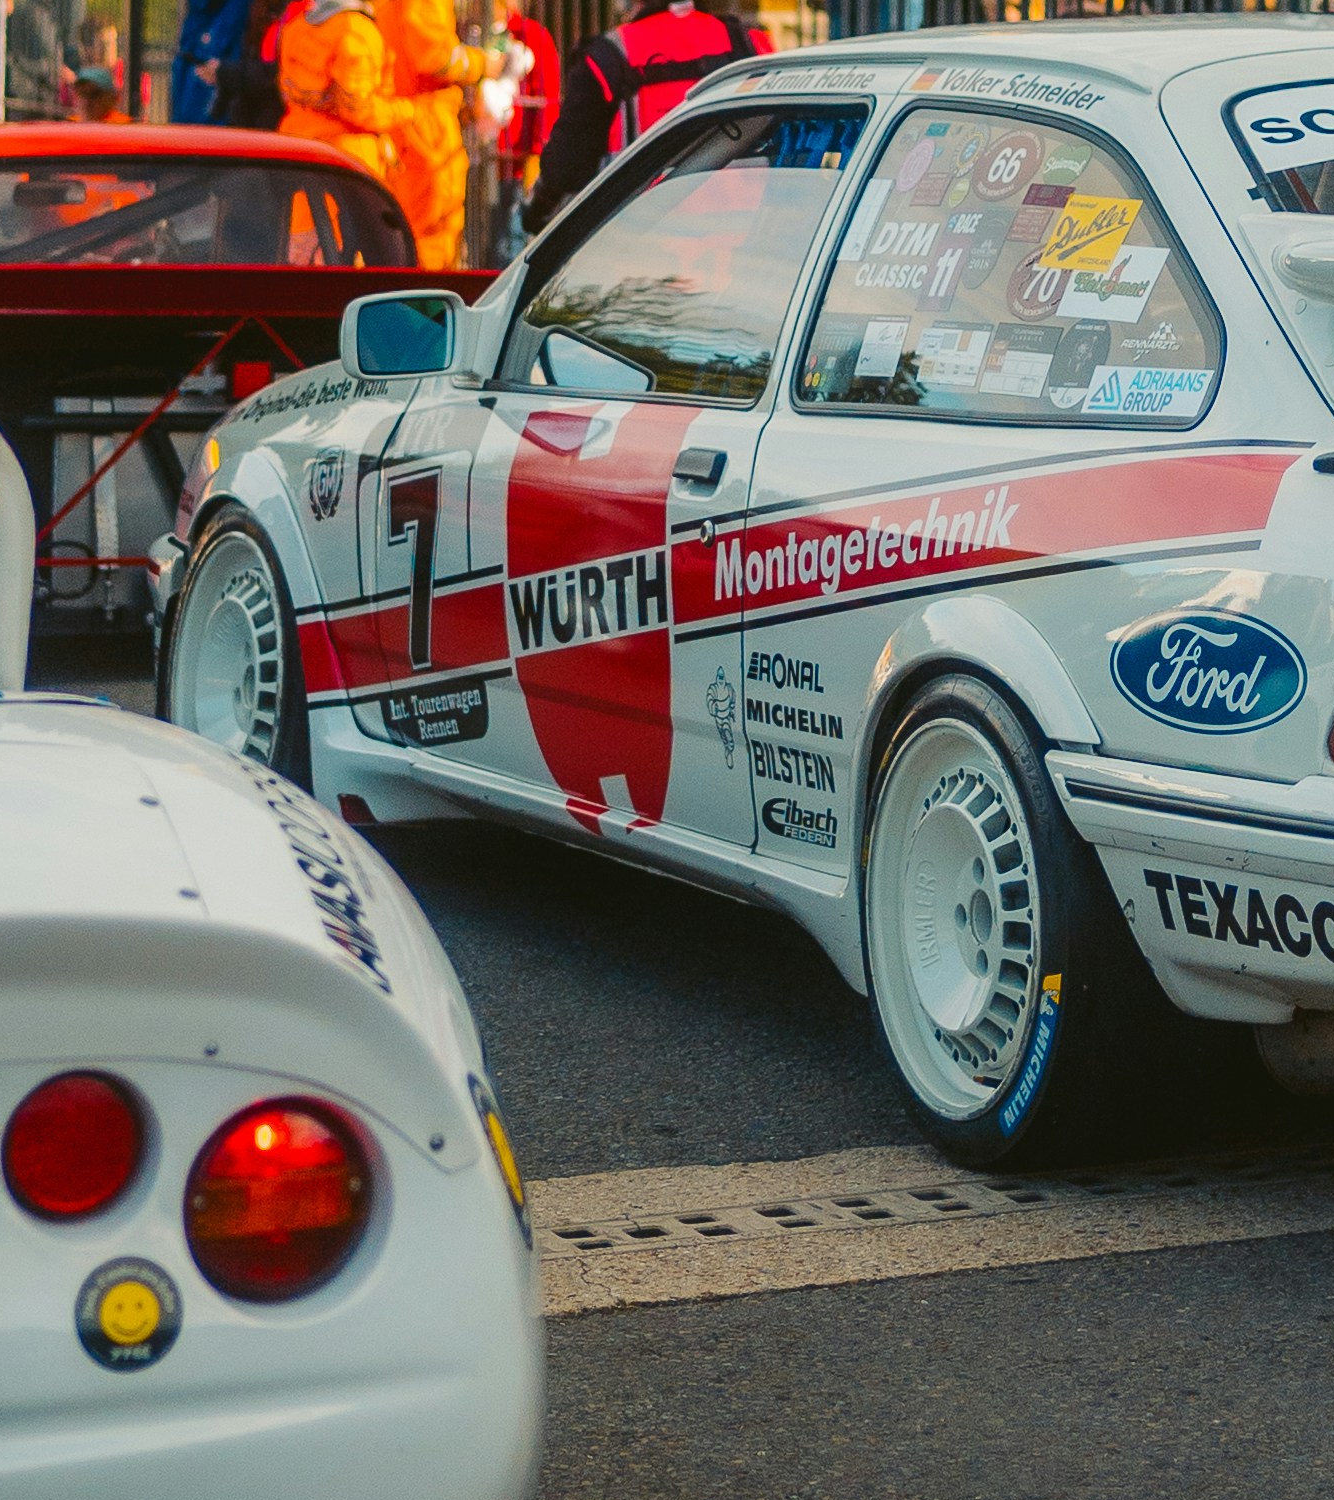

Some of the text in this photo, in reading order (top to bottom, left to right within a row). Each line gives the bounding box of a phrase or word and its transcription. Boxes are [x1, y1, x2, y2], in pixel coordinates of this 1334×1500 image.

[762, 67, 875, 90] Armin Hahne
[943, 69, 1105, 110] Volker Schneider
[987, 147, 1027, 184] 66
[869, 222, 940, 257] DTM
[855, 264, 928, 289] CLASSIC
[1023, 264, 1062, 303] 70
[318, 377, 353, 403] beste
[1129, 370, 1207, 393] ADRIAANS
[1122, 392, 1173, 412] GROUP
[386, 466, 443, 670] 7
[509, 486, 1020, 651] WÜRTH Montagetechnik
[758, 652, 824, 693] RONAL
[1147, 624, 1266, 715] Ford
[411, 689, 482, 714] Tourenwagen
[746, 698, 843, 739] MICHELIN
[418, 719, 459, 740] Rennen
[750, 739, 836, 793] BILSTEIN
[762, 798, 838, 837] Eibach
[783, 825, 834, 847] FEDERN
[1003, 1020, 1051, 1128] MICHELIN
